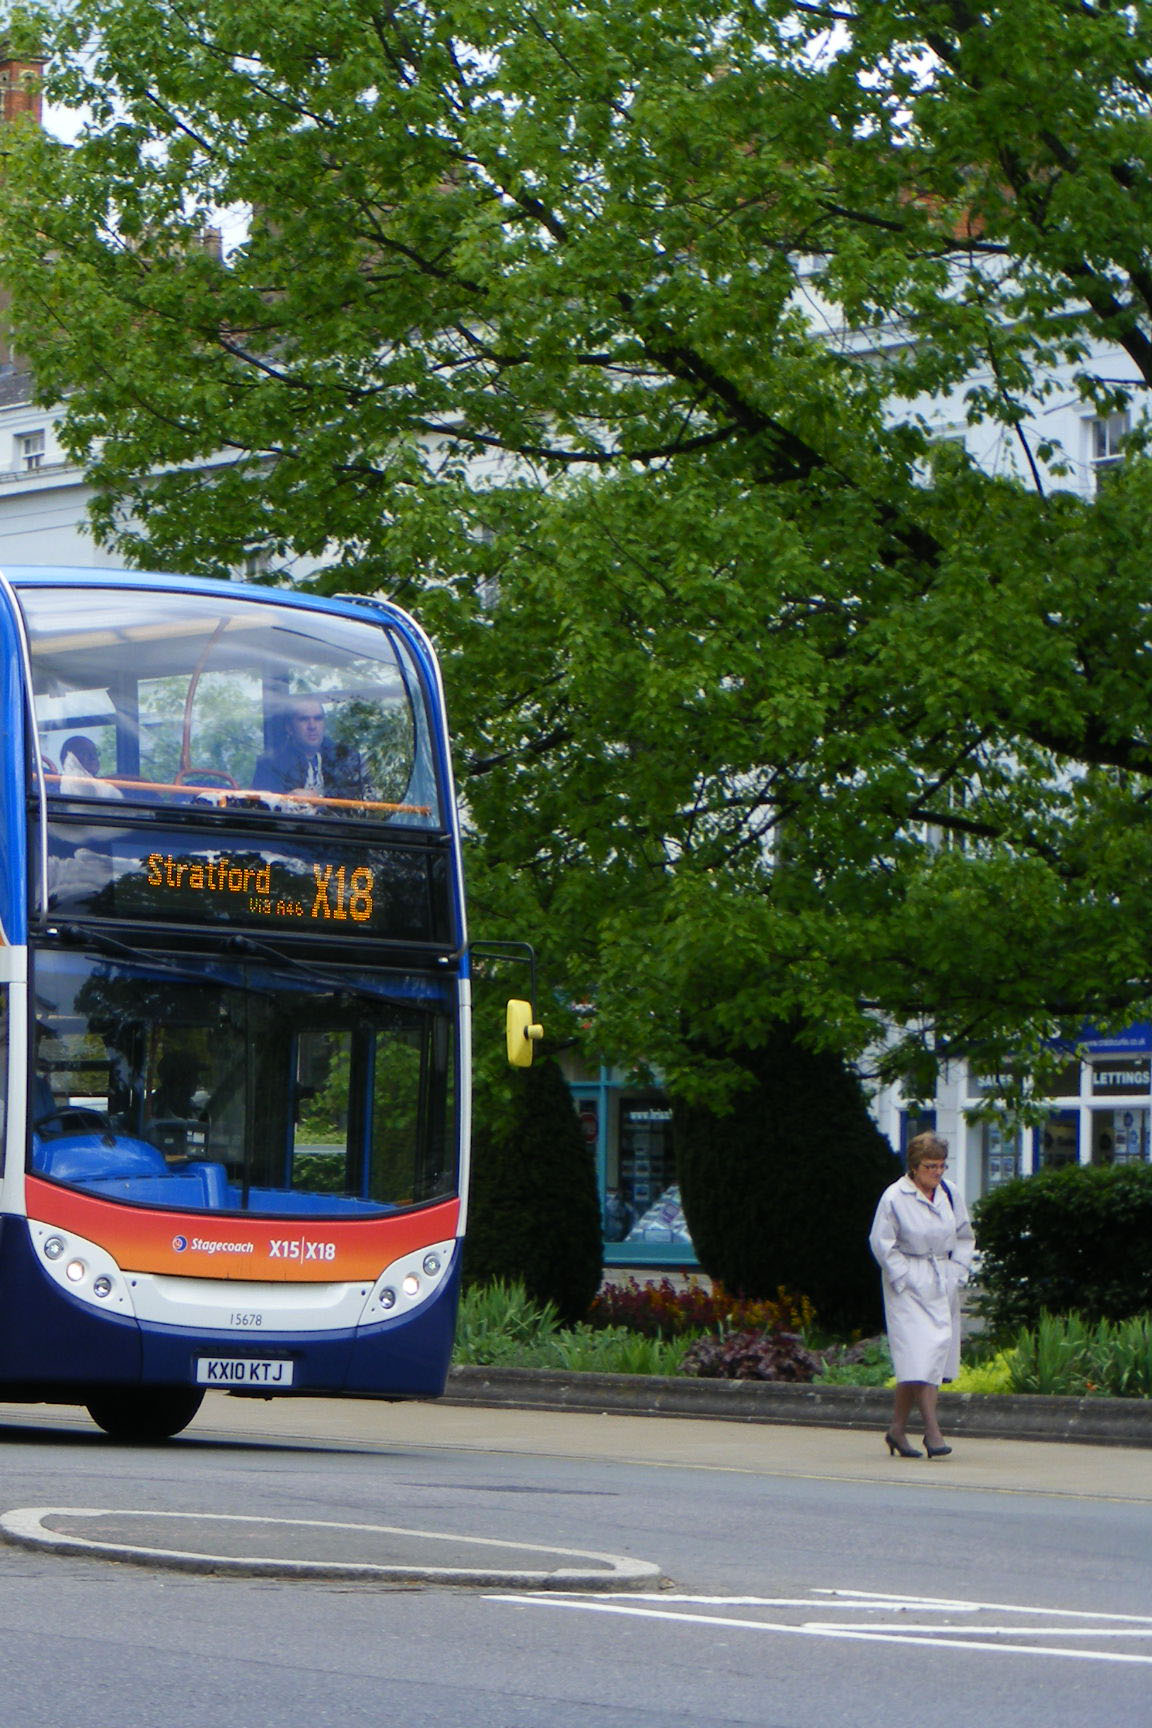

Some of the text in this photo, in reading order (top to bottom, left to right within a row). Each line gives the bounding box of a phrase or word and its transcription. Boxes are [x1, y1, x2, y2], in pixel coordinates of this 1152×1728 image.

[148, 852, 272, 895] Stratford
[311, 863, 374, 921] X18
[275, 900, 304, 917] A46
[1093, 1071, 1150, 1085] LETTINGS
[191, 1238, 254, 1254] Stagecoach
[269, 1240, 336, 1260] X15 X18
[230, 1313, 263, 1326] 15678
[208, 1362, 282, 1381] KX10 KTJ
